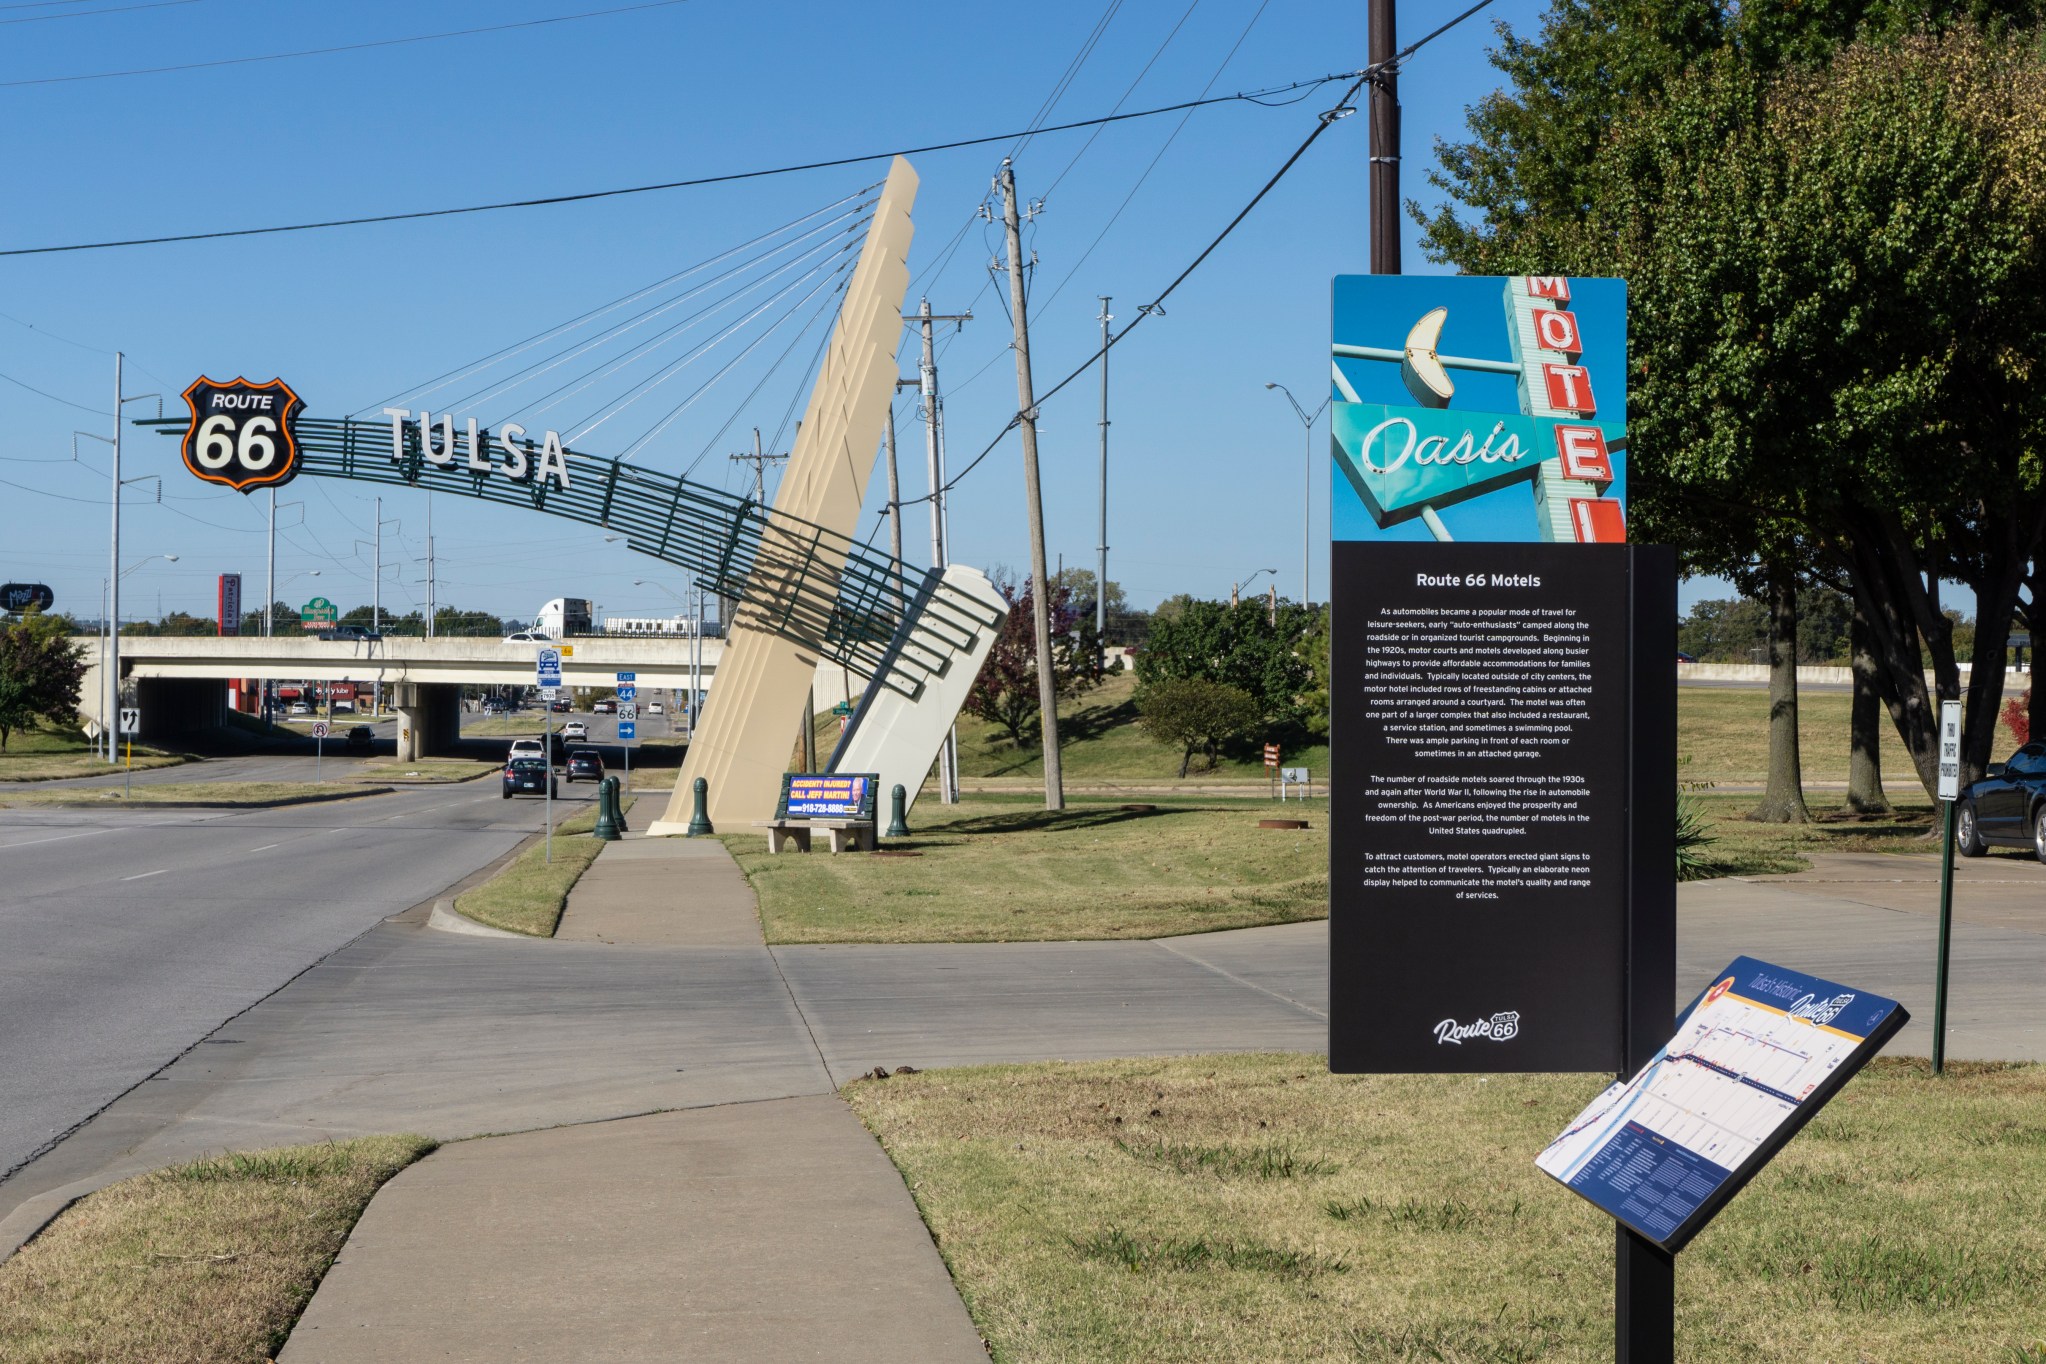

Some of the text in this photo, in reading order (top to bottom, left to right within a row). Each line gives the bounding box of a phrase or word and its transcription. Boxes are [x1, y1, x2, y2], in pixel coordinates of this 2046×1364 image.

[211, 393, 274, 410] ROUTE
[195, 414, 278, 471] 66
[1361, 417, 1529, 474] Oasis
[383, 407, 571, 489] TULSA
[1417, 573, 1541, 587] Route 66 Motels
[226, 578, 236, 625] Patrician
[1478, 608, 1507, 616] popular
[1368, 620, 1427, 629] leisure-seekers,
[1428, 621, 1448, 630] early
[1522, 622, 1552, 630] camped
[1554, 622, 1574, 630] along
[1382, 646, 1406, 654] 1920s,
[1502, 647, 1541, 655] developed
[1542, 647, 1564, 656] along
[1366, 659, 1400, 668] highways
[1412, 660, 1441, 668] provide
[620, 690, 633, 698] 44
[1473, 685, 1520, 694] freestanding
[1396, 698, 1430, 707] arranged
[1467, 698, 1506, 707] courtyard.
[619, 709, 634, 720] 66
[1419, 724, 1448, 732] station,
[1515, 724, 1552, 733] swimming
[1554, 724, 1572, 733] pool.
[1426, 737, 1449, 745] ample
[1451, 737, 1479, 746] parking
[792, 780, 852, 788] ACCIDENT? INJURED?
[1516, 776, 1546, 784] through
[790, 790, 806, 799] CALL
[806, 790, 822, 799] JEFF
[1380, 788, 1402, 797] again
[1473, 788, 1507, 797] following
[1423, 814, 1456, 822] post-war
[1458, 814, 1484, 822] period,
[1488, 866, 1521, 874] Typically
[1364, 878, 1390, 887] display
[1392, 878, 1418, 887] helped
[1526, 878, 1552, 887] quality
[1495, 1014, 1515, 1022] TULSA
[1816, 1006, 1840, 1022] 66
[1433, 1018, 1491, 1045] Route
[1493, 1023, 1514, 1038] 66
